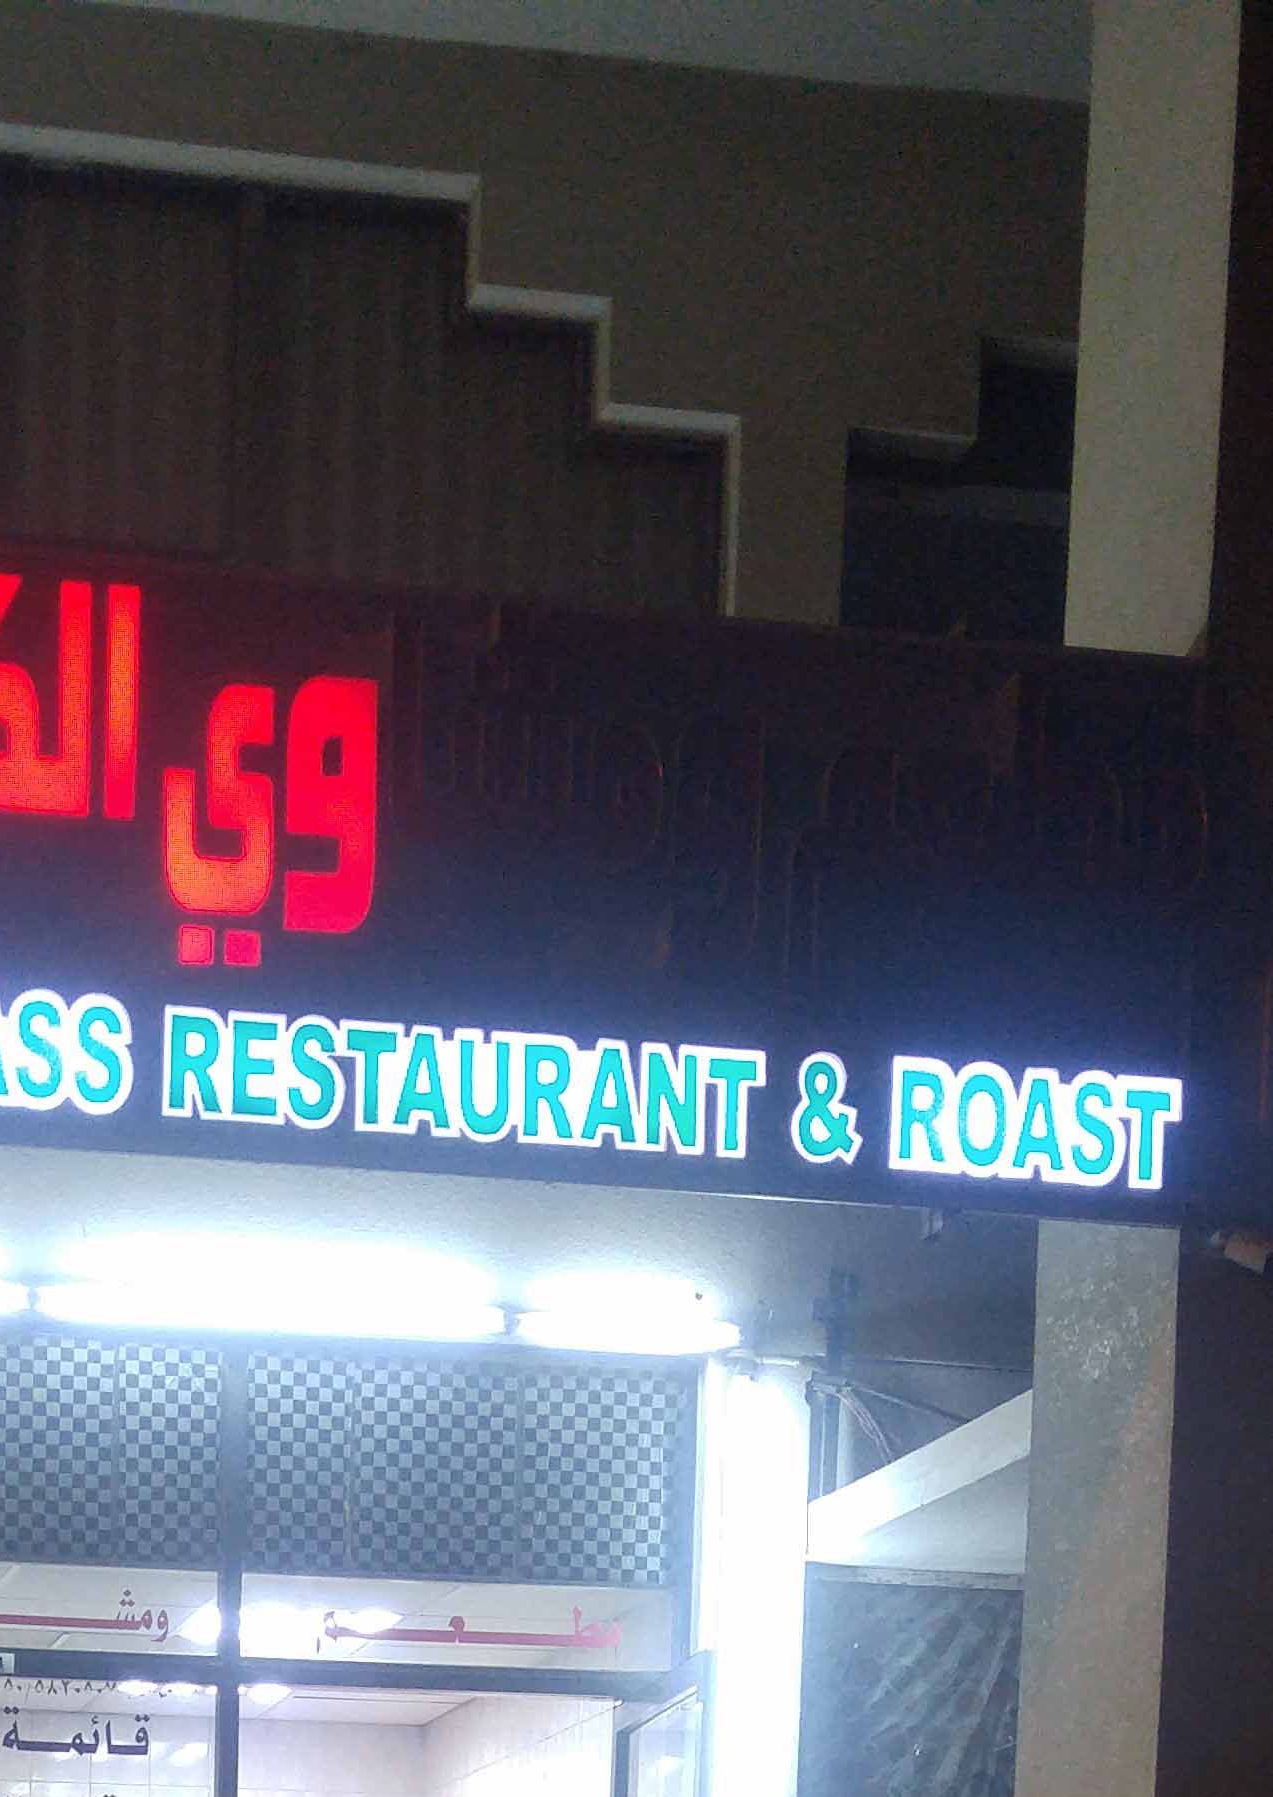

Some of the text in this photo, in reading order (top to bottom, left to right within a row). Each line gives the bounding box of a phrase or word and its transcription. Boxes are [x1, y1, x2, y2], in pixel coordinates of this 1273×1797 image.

[163, 1005, 767, 1159] RESTAURANT
[791, 1050, 862, 1166] &
[888, 1054, 1182, 1190] ROAST
[2, 1705, 150, 1756] قائمة
